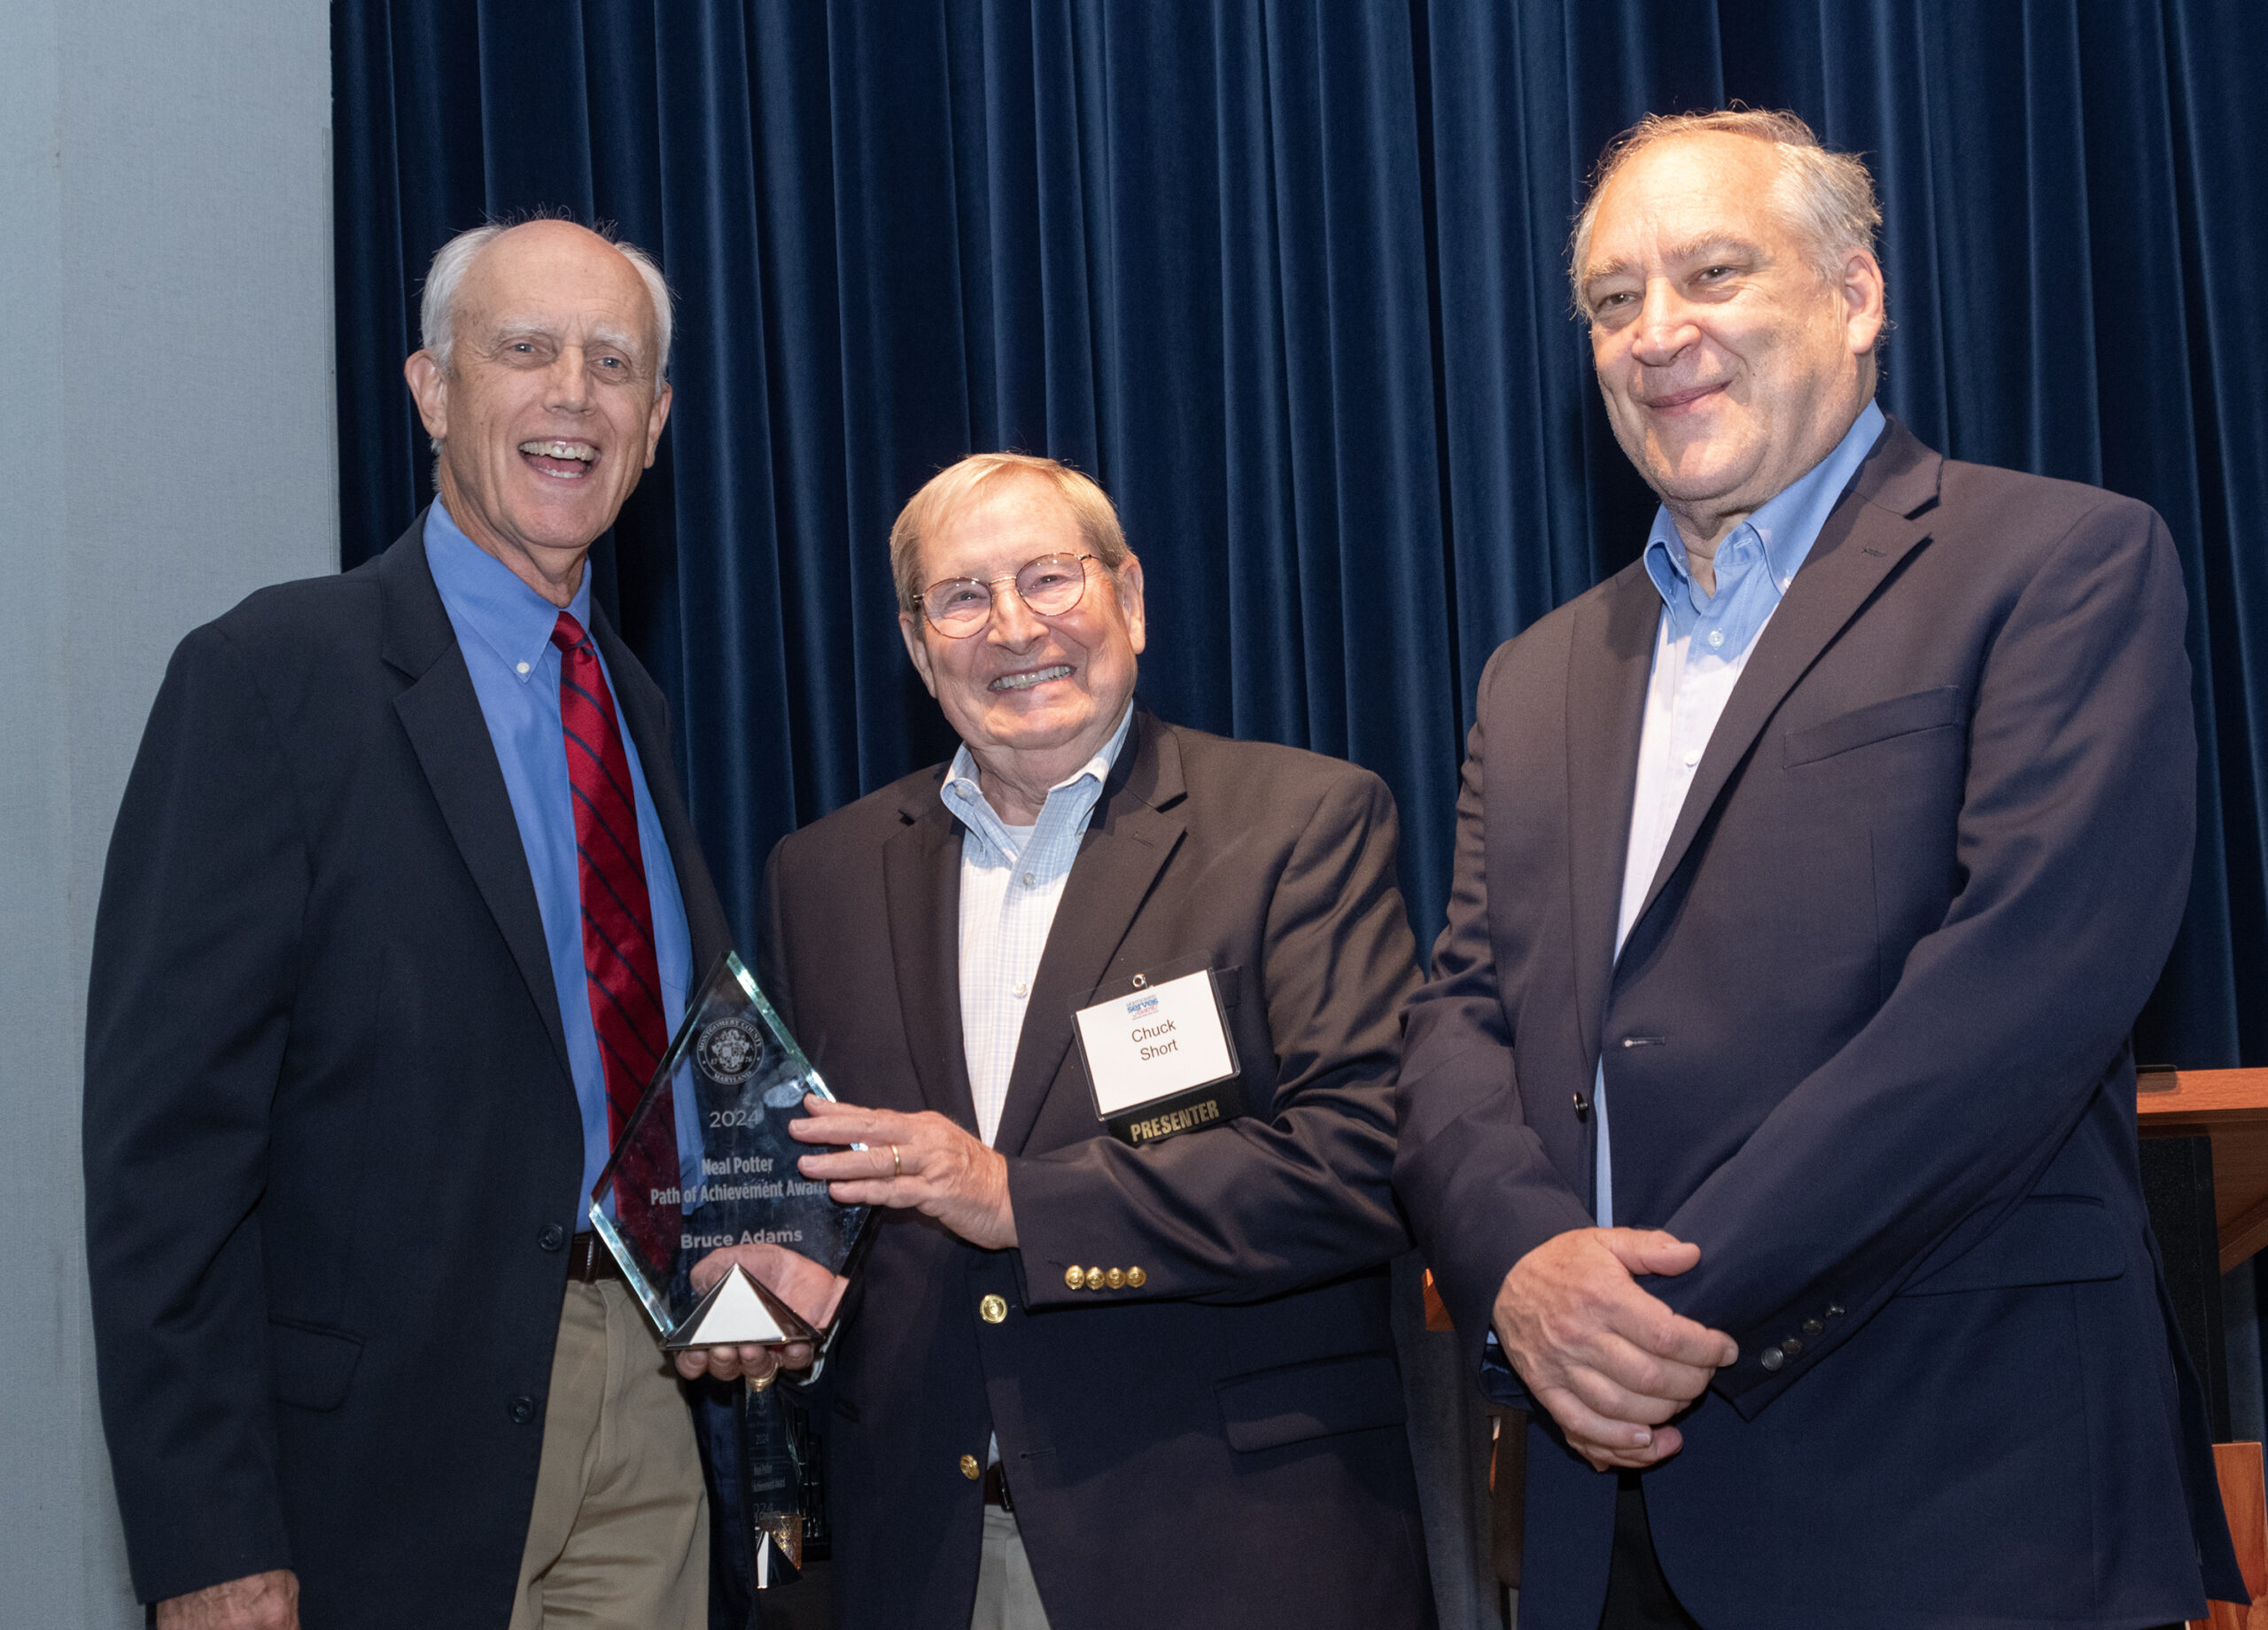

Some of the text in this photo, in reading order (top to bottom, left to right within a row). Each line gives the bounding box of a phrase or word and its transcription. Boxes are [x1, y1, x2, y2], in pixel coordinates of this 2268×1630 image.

[698, 1019, 763, 1052] MONTGOMERY COUNTY
[1131, 1019, 1177, 1043] Chuck
[1139, 1039, 1178, 1061] Short
[714, 1070, 752, 1083] MARYLAND
[709, 1110, 761, 1128] 2024
[1130, 1099, 1220, 1143] PRESENTER
[702, 1156, 773, 1176] Neal Potter
[650, 1179, 827, 1205] Path of Achievement Award
[680, 1228, 803, 1249] Bruce Adams
